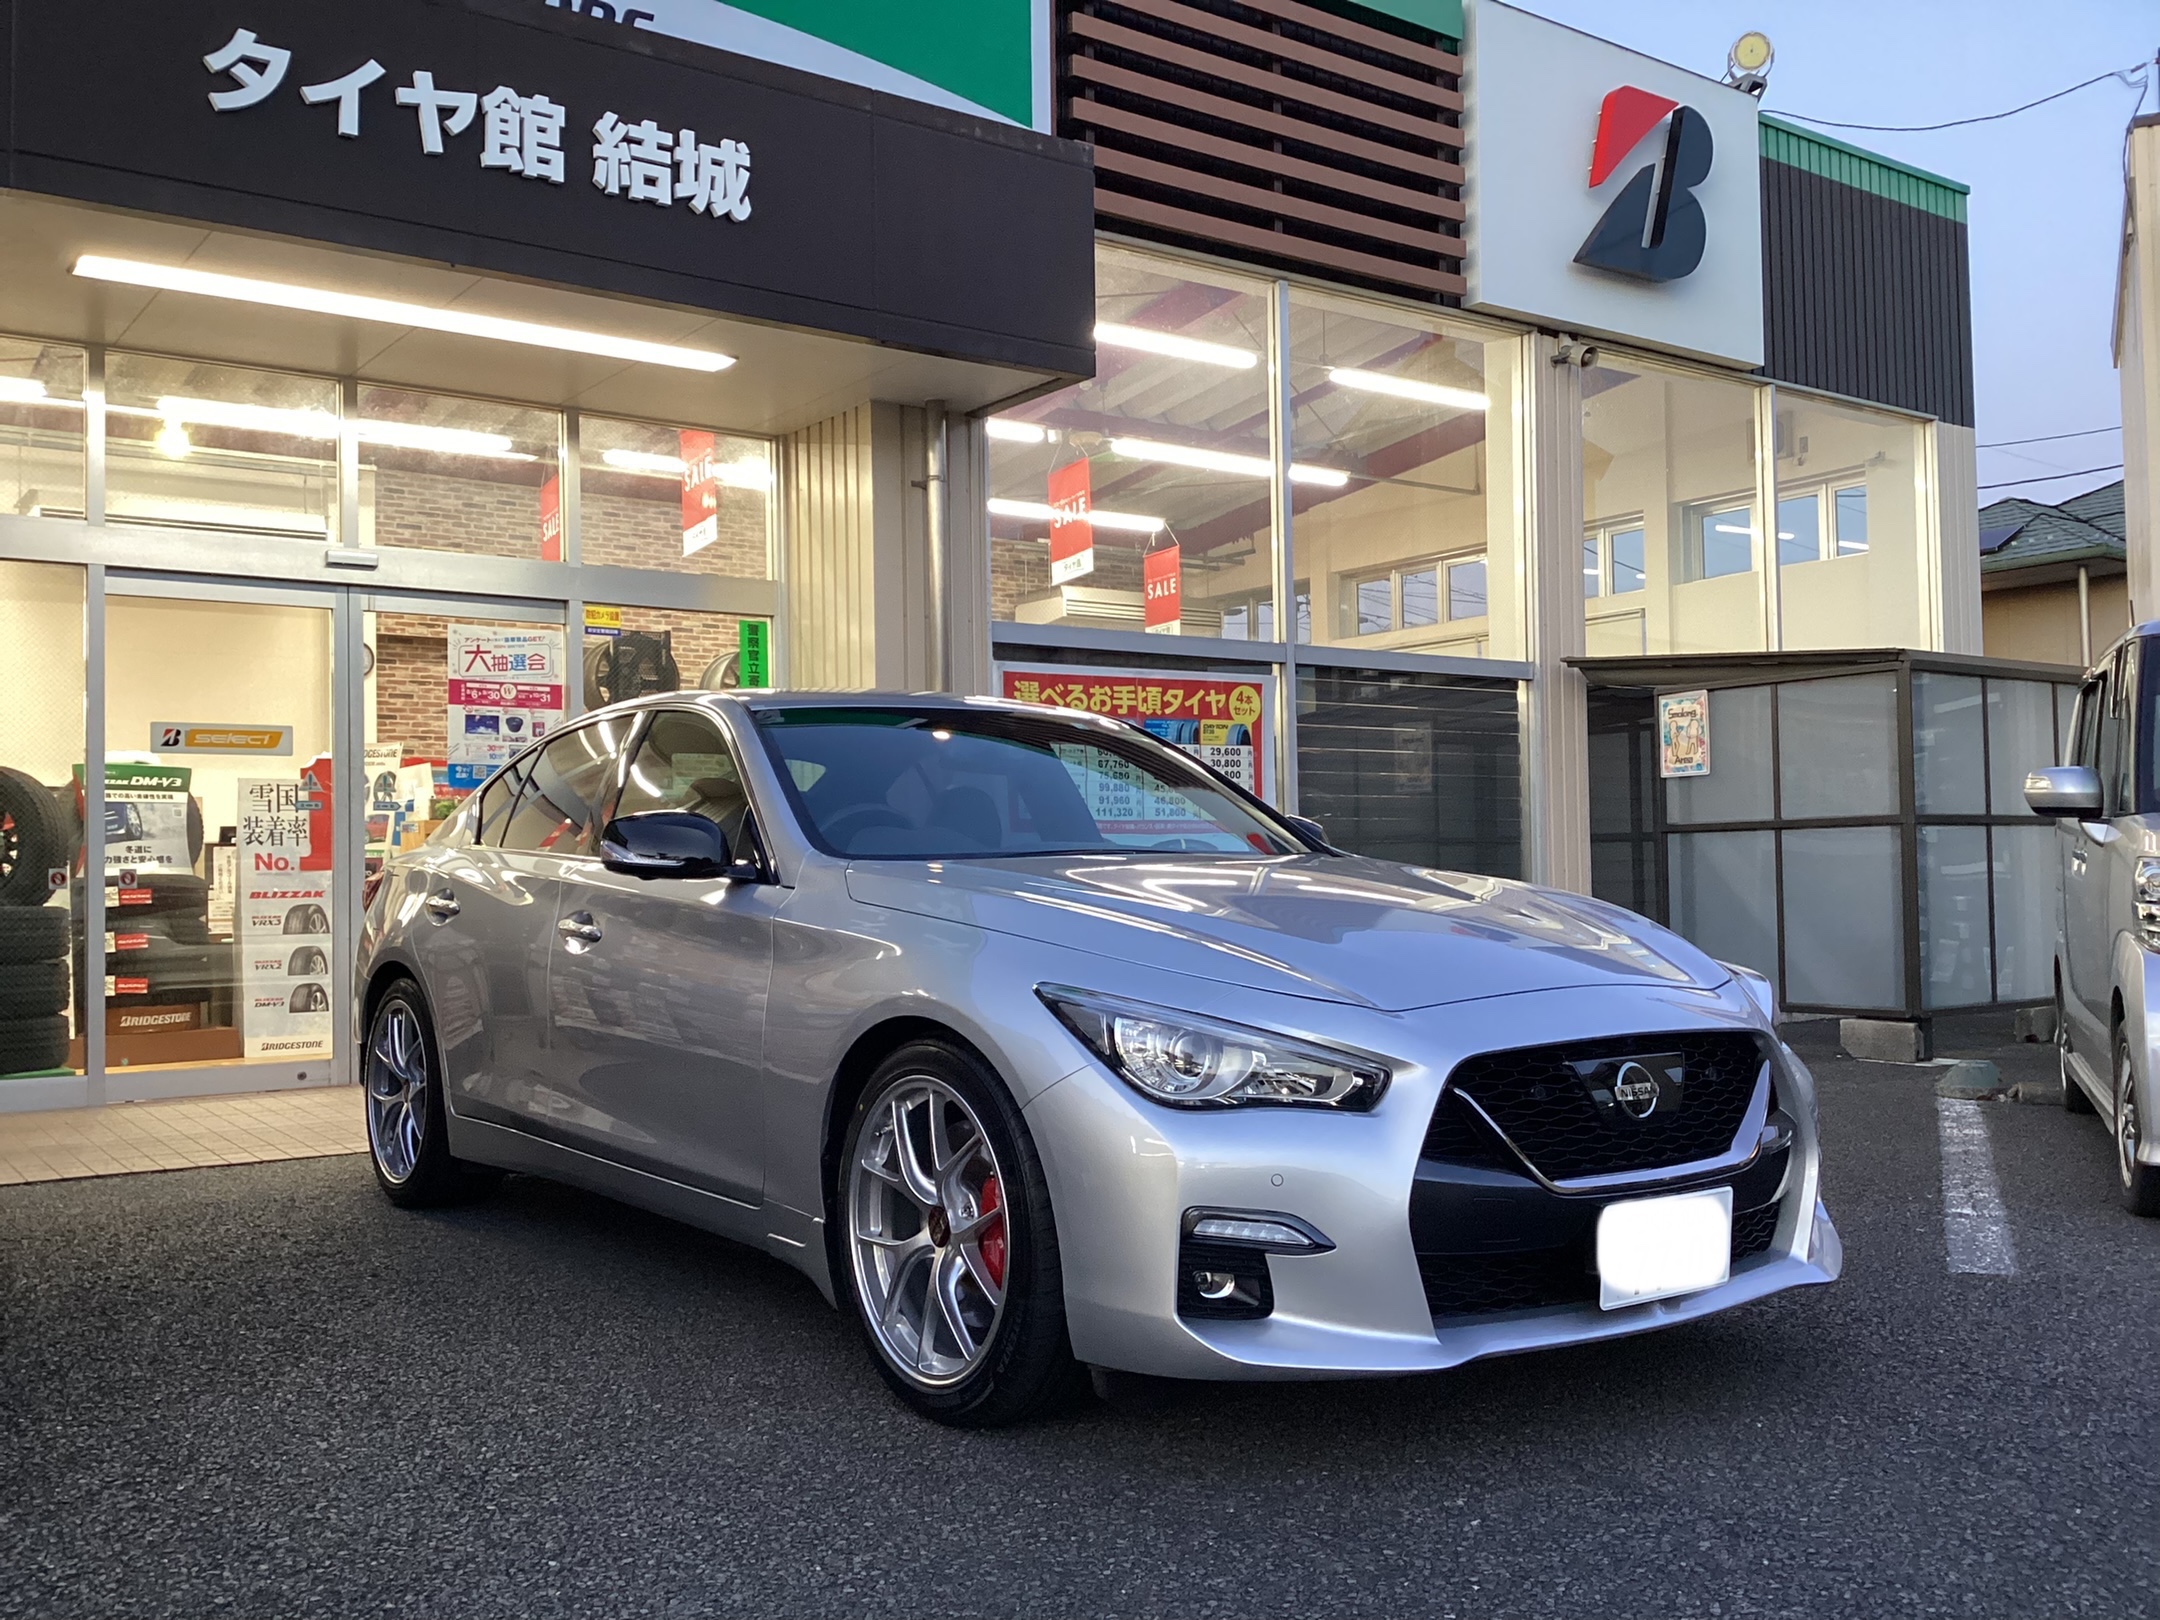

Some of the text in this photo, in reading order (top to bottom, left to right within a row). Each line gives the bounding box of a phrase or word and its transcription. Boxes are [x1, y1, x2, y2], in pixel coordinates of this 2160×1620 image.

[203, 28, 752, 223] タイヤ館 結城
[684, 455, 713, 492] SALE
[1054, 497, 1087, 528] SALE
[543, 513, 560, 542] SALE
[1147, 577, 1177, 600] SALE
[464, 644, 546, 673] 大抽選会
[1013, 680, 1227, 716] 選べるお手頃タイヤ
[1236, 690, 1253, 704] 4本
[1233, 706, 1256, 716] セット
[1668, 708, 1698, 720] Smoking
[194, 732, 271, 745] select
[1210, 747, 1241, 757] 29,600
[1098, 759, 1130, 769] 67,760
[1211, 758, 1241, 769] 30,800
[1674, 756, 1693, 764] Area
[130, 776, 182, 788] DM-V3
[1099, 783, 1130, 793] 99,880
[249, 783, 299, 813] 雪国
[1096, 807, 1133, 818] 111,320
[242, 816, 308, 847] 装着率
[125, 845, 152, 854] 冬道に
[254, 853, 296, 871] No.
[249, 890, 325, 900] BLIZZAK
[252, 919, 282, 927] VRX3
[254, 963, 282, 971] VRX2
[119, 1012, 192, 1028] BRIDGESTONE
[260, 1040, 324, 1051] BRIDGESTONE
[1620, 1085, 1656, 1098] NISSAN
